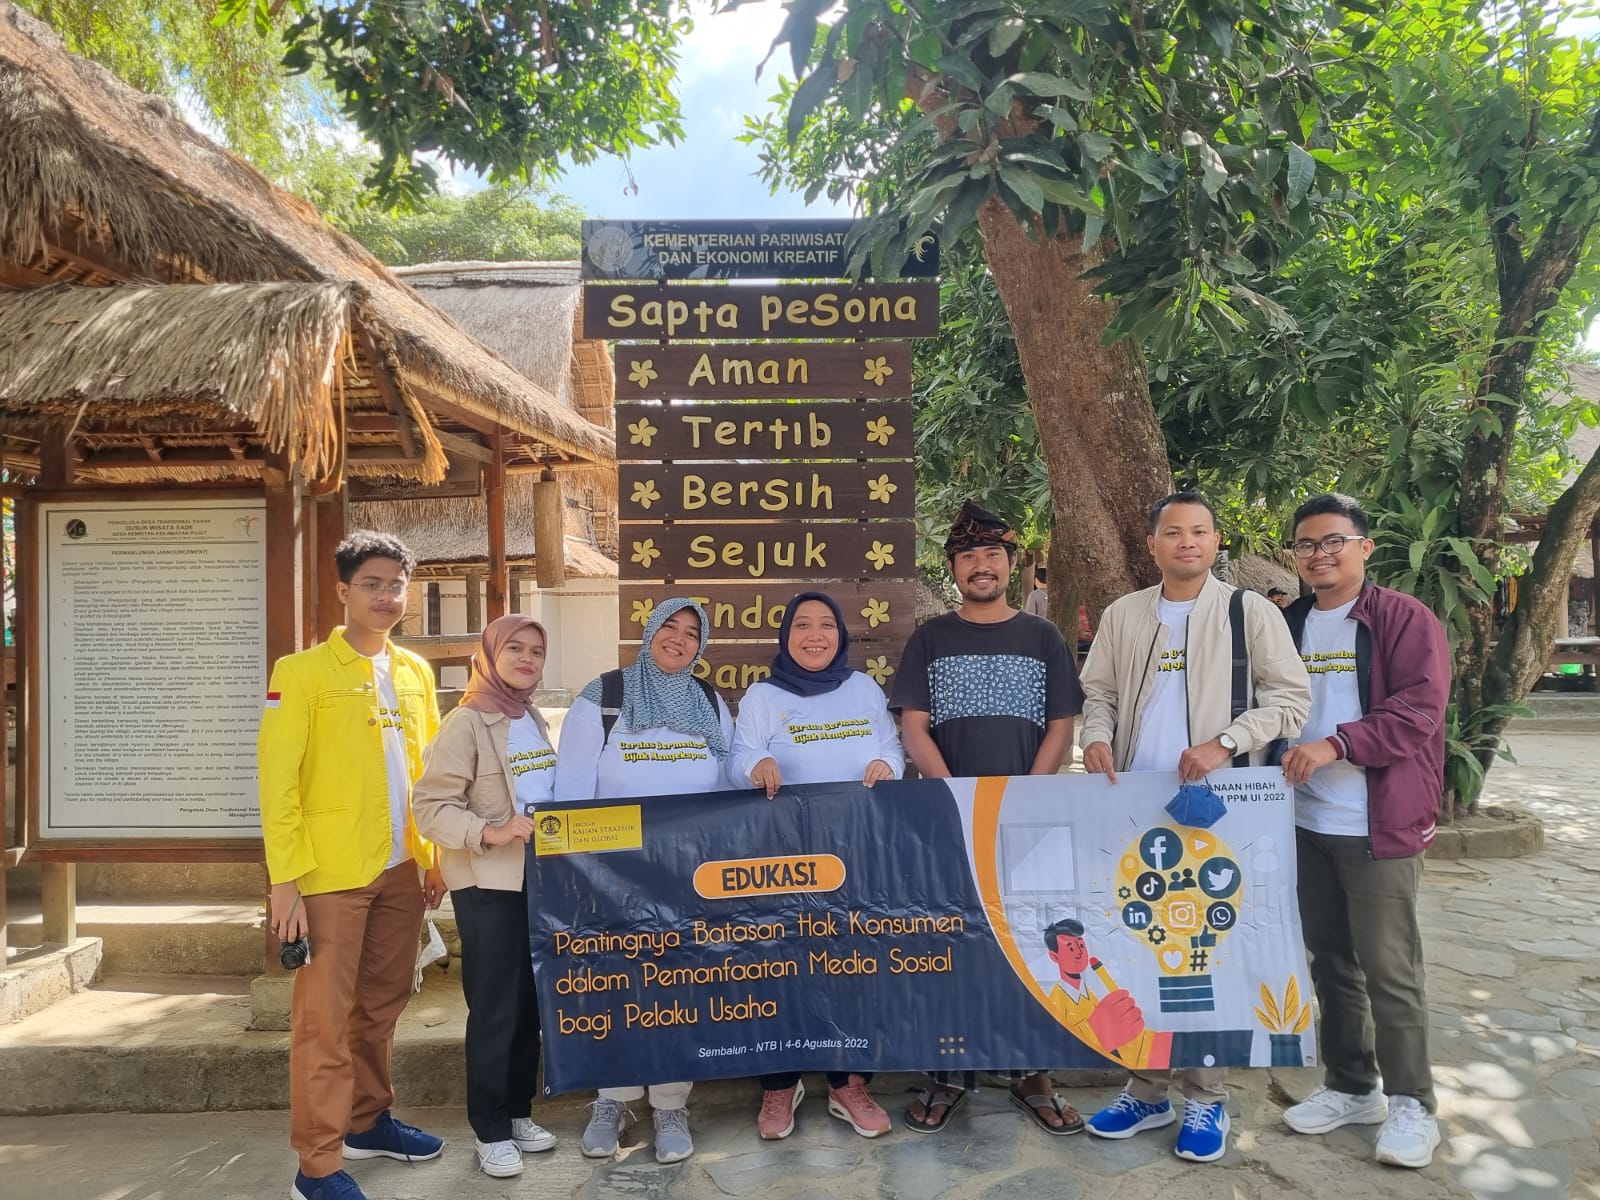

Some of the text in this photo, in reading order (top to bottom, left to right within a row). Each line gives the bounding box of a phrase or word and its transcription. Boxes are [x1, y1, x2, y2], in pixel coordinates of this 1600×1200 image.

[643, 233, 756, 247] KEMENTERIAN
[659, 250, 839, 265] DAN EKONOMI KREATIF
[607, 293, 739, 336] Sapta
[687, 353, 809, 387] Aman
[687, 531, 827, 577] Sejuk
[688, 594, 788, 630] nda
[1226, 794, 1248, 803] PPM
[1250, 793, 1261, 803] UI
[1263, 792, 1286, 802] 2022
[1245, 781, 1276, 791] HIBAH
[591, 834, 619, 843] GLOBAL
[721, 861, 818, 892] EDUKASI
[553, 909, 964, 960] Pentingnya Batasan Hak Konsumen
[555, 946, 953, 996] dalam Pemanfaatan Media Sosial
[556, 993, 778, 1040] bagi Pelaku Usaha
[698, 1045, 747, 1058] Sembalun
[755, 1040, 778, 1053] NTB
[785, 1038, 801, 1049] 4-6
[802, 1038, 843, 1051] Agustus
[844, 1038, 869, 1049] 2022
